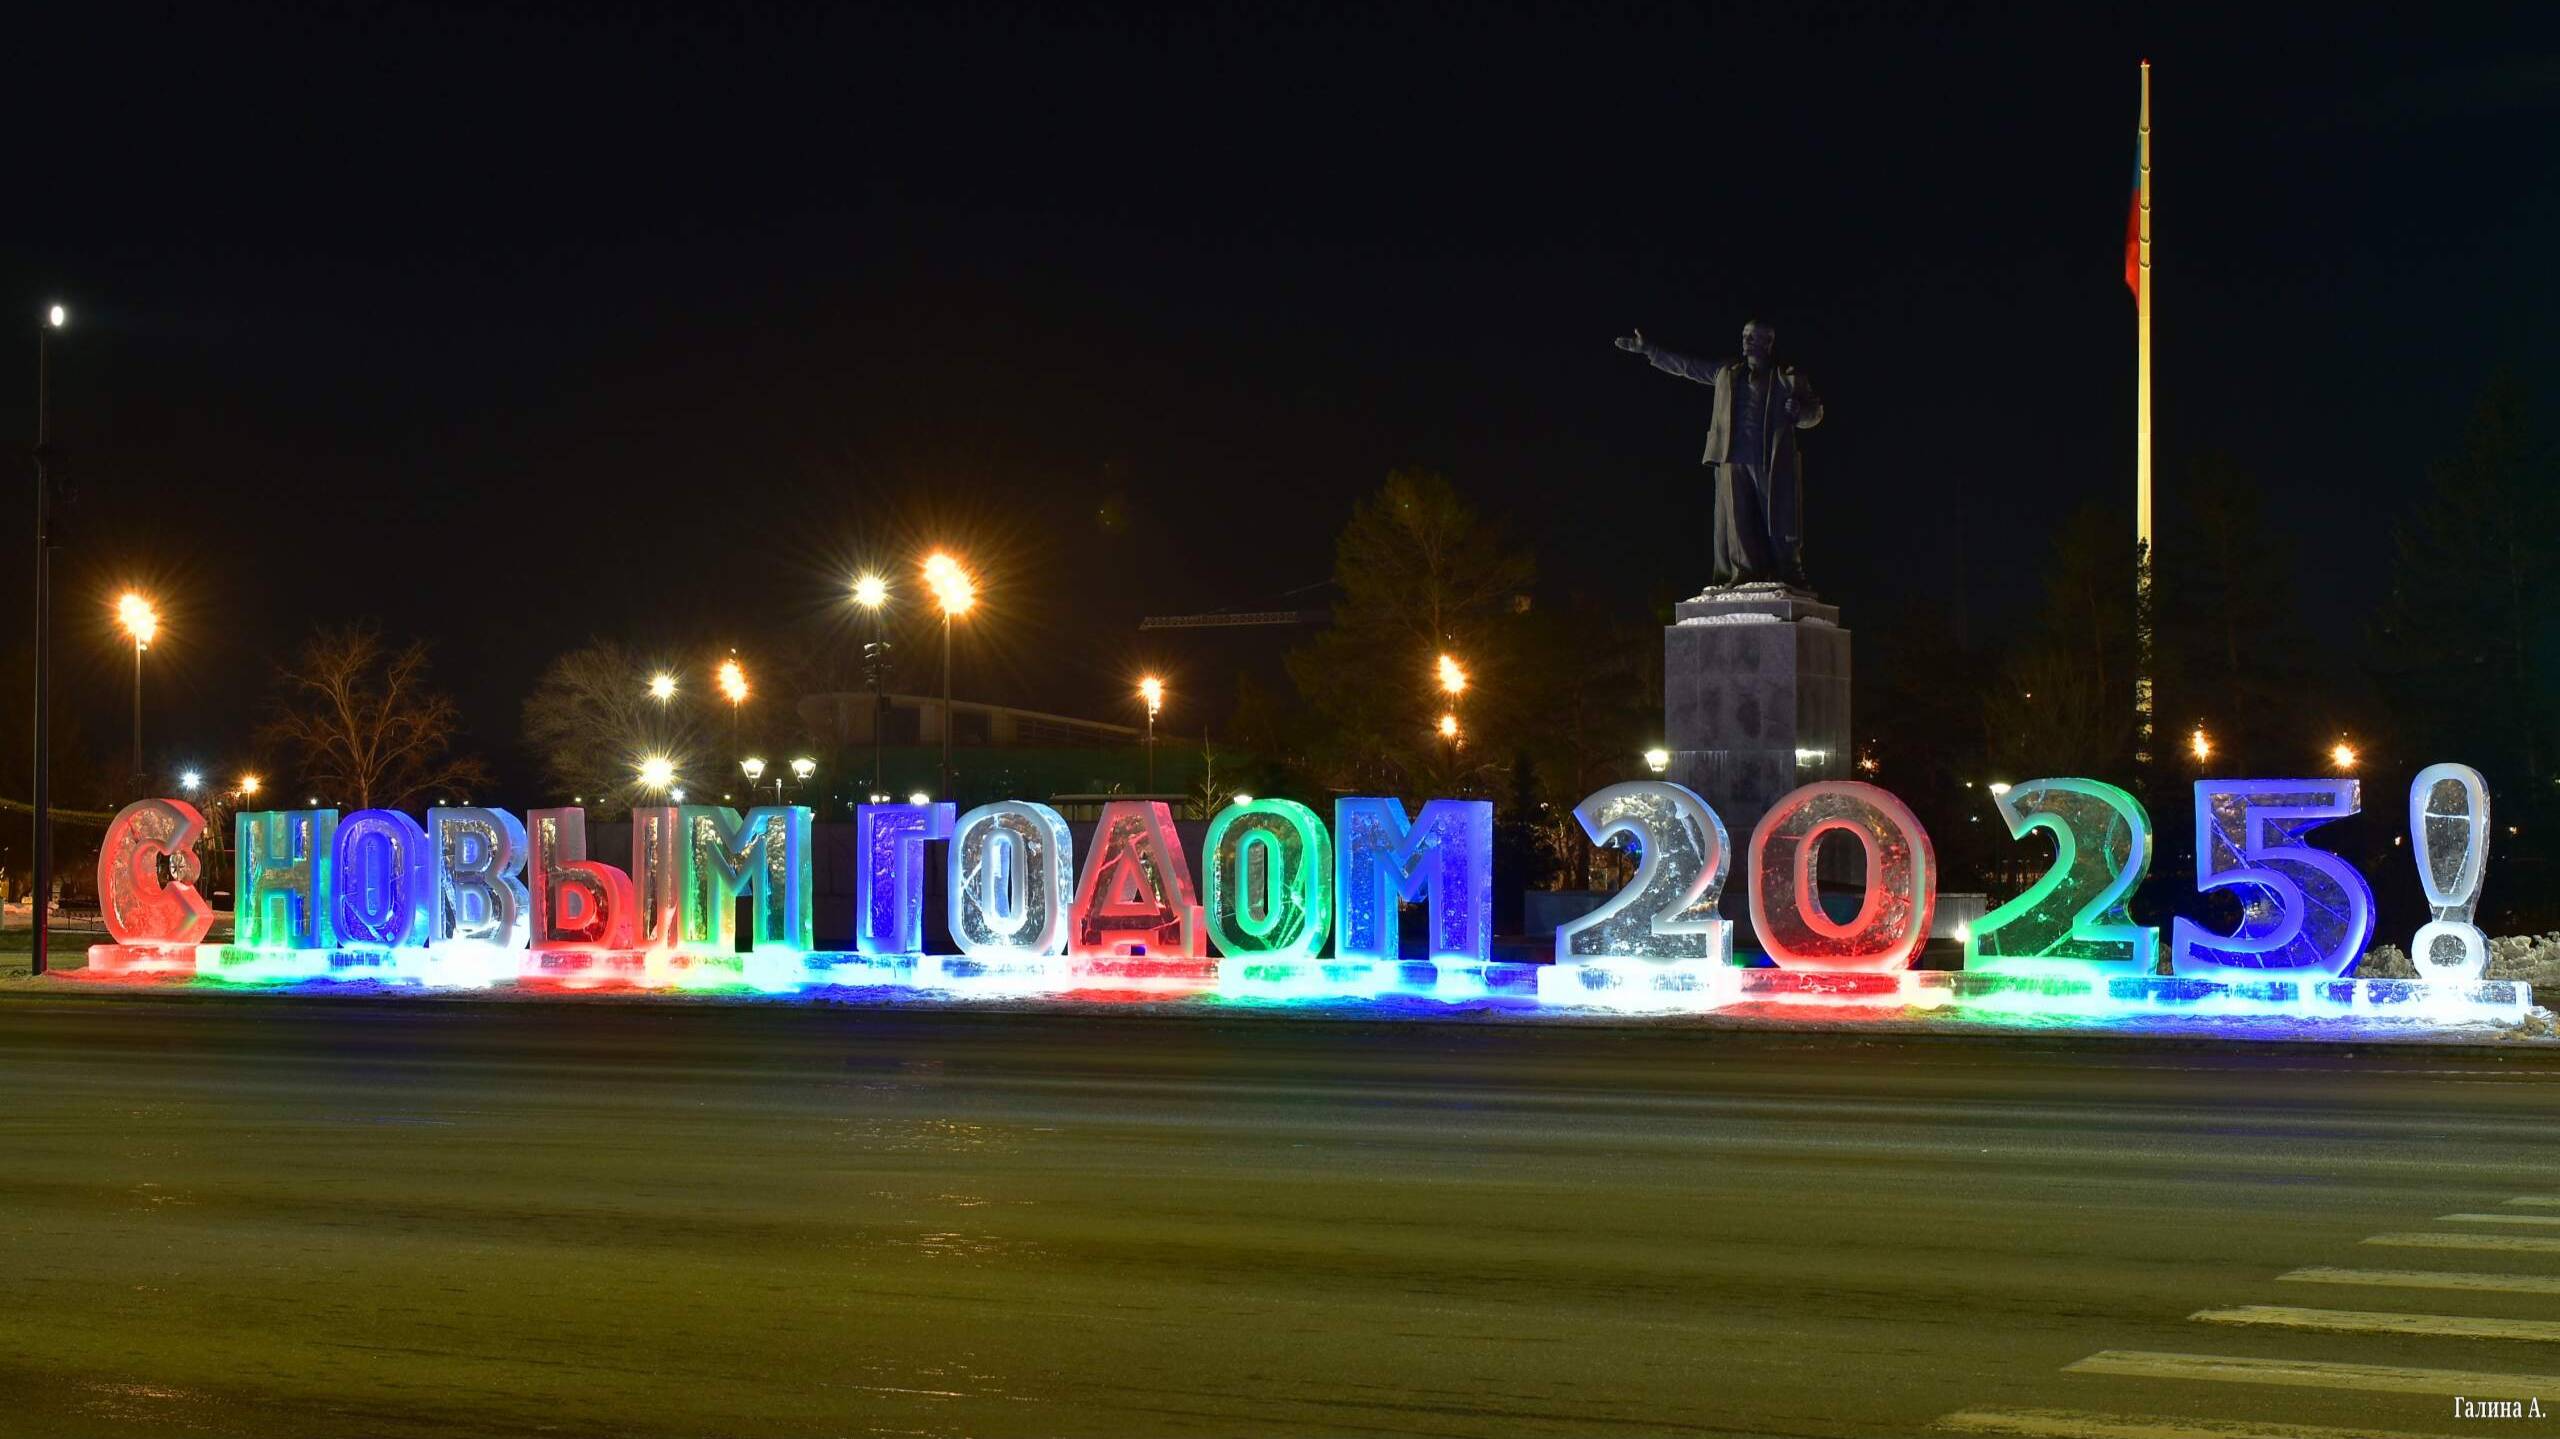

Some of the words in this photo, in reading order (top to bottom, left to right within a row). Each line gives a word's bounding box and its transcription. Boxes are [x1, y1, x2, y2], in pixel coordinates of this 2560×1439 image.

[98, 799, 214, 947] С
[234, 806, 814, 952] НОВЫМ
[856, 797, 1494, 961] ГОДОМ
[1555, 762, 2490, 984] 2025!
